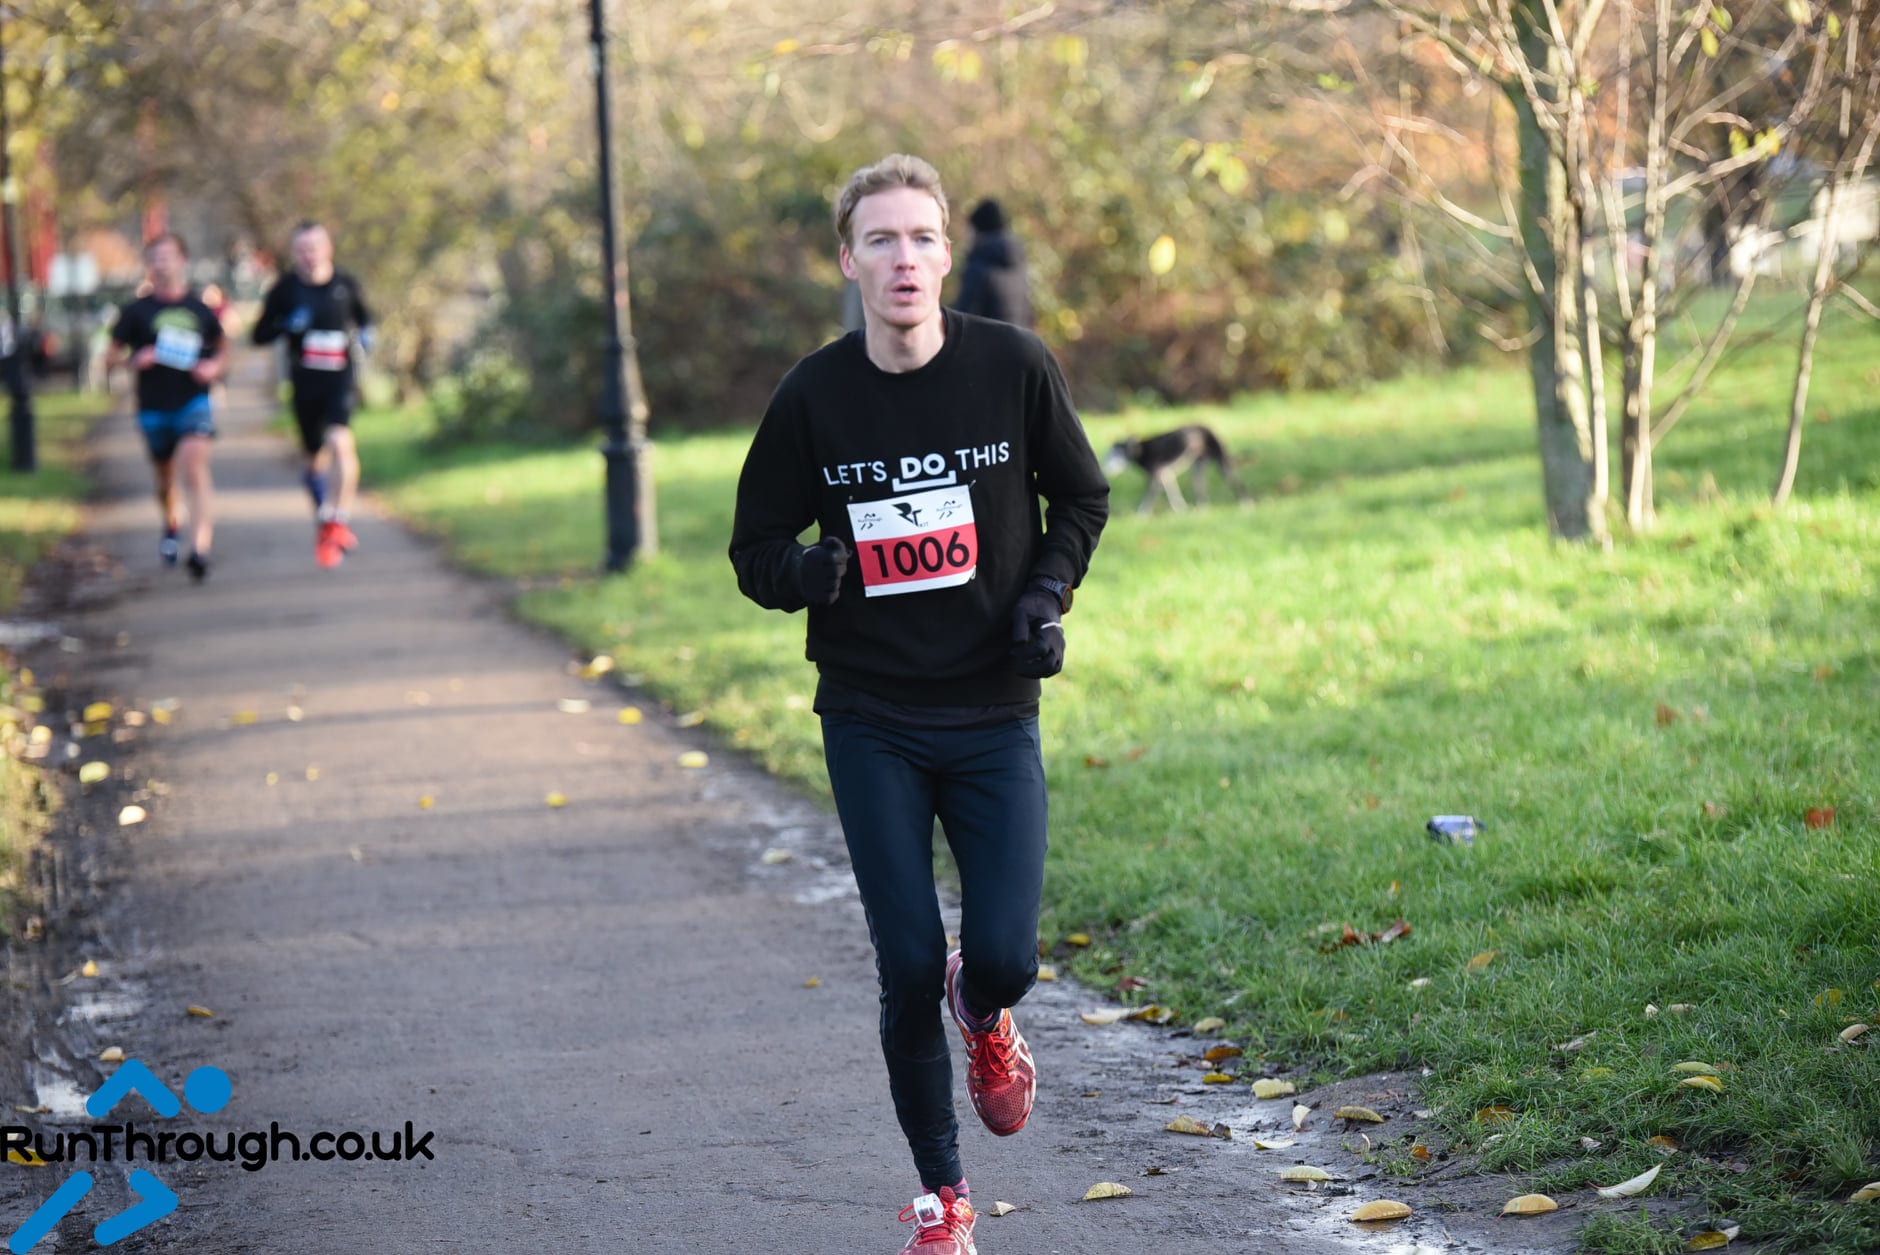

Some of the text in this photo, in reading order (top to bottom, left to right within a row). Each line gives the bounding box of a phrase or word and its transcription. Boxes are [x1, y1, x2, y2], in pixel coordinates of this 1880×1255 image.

[823, 441, 1010, 486] LET'S DO THIS
[872, 531, 970, 578] 1006
